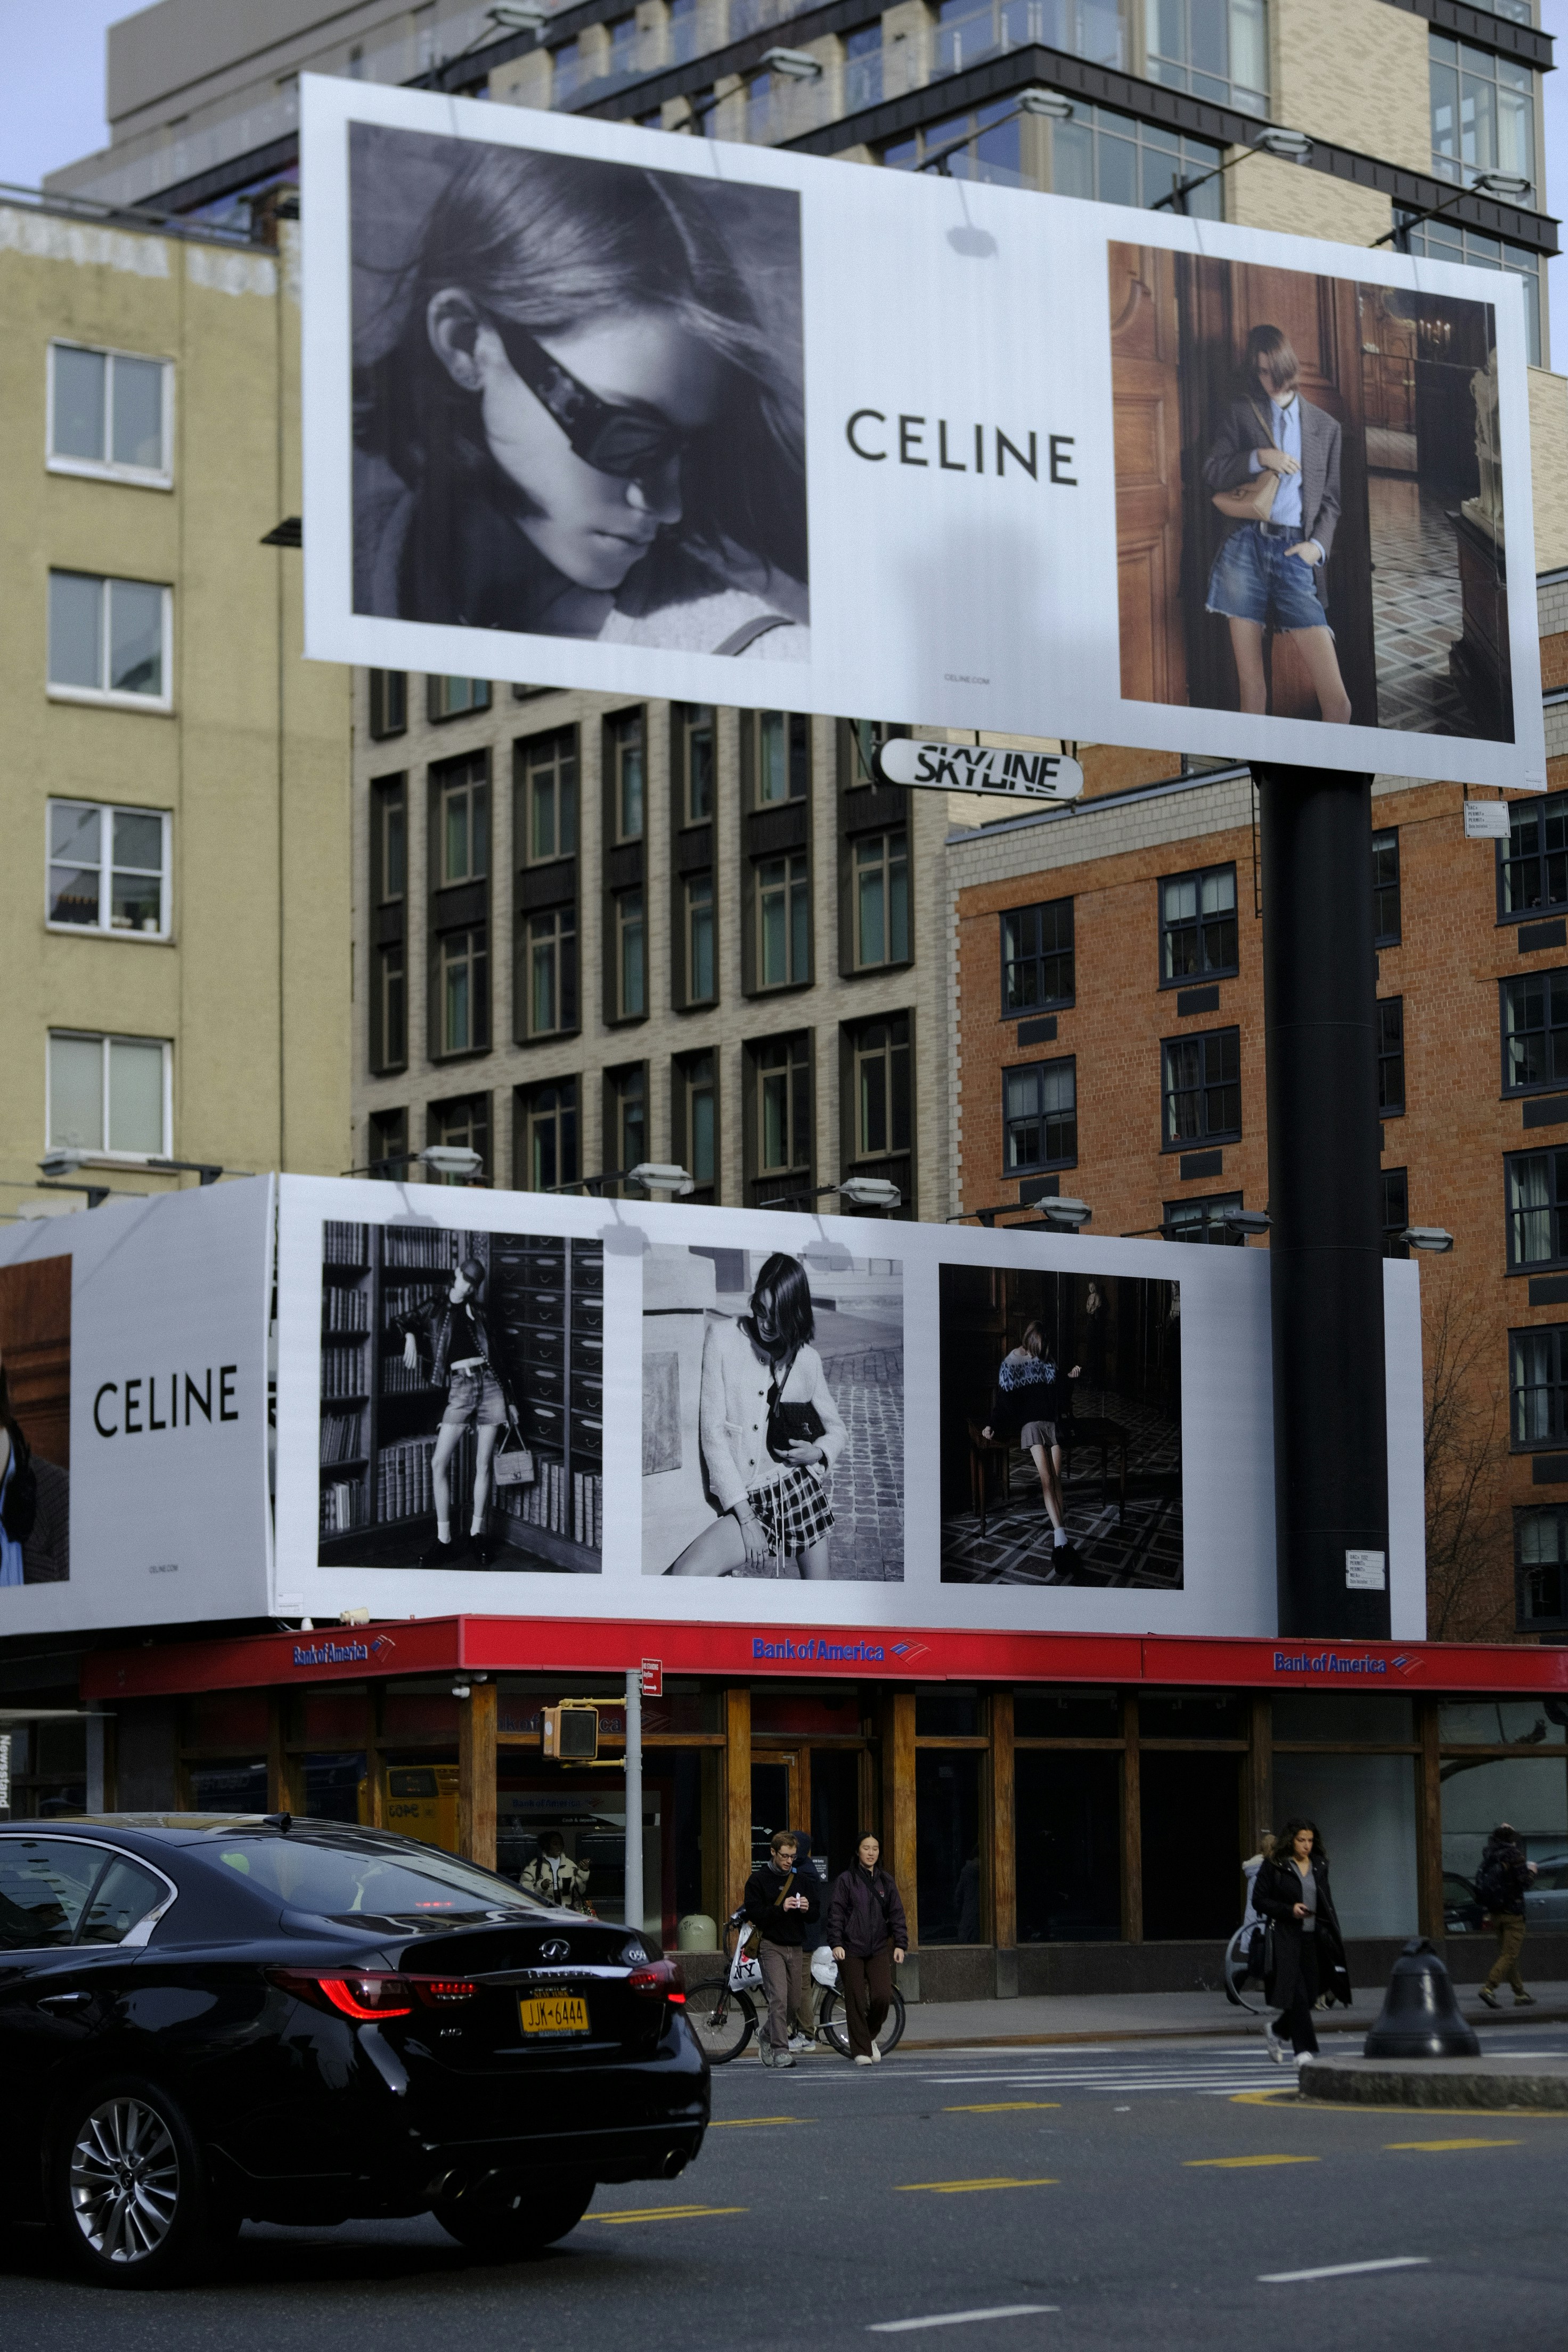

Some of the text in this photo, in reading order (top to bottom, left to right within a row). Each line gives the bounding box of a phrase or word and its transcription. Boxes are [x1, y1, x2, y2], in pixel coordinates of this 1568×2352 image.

[845, 409, 1078, 486] CELINE
[944, 673, 990, 684] CELINE.COM
[914, 745, 1060, 794] SKYLINE
[94, 1365, 238, 1438] CELINE
[149, 1564, 178, 1573] CELINE.COM
[294, 1640, 368, 1666] Bank of America
[752, 1638, 884, 1661] Bank of America
[1273, 1652, 1386, 1673] Bank of America
[733, 1962, 755, 1979] NY
[528, 2000, 583, 2026] JJK 6444
